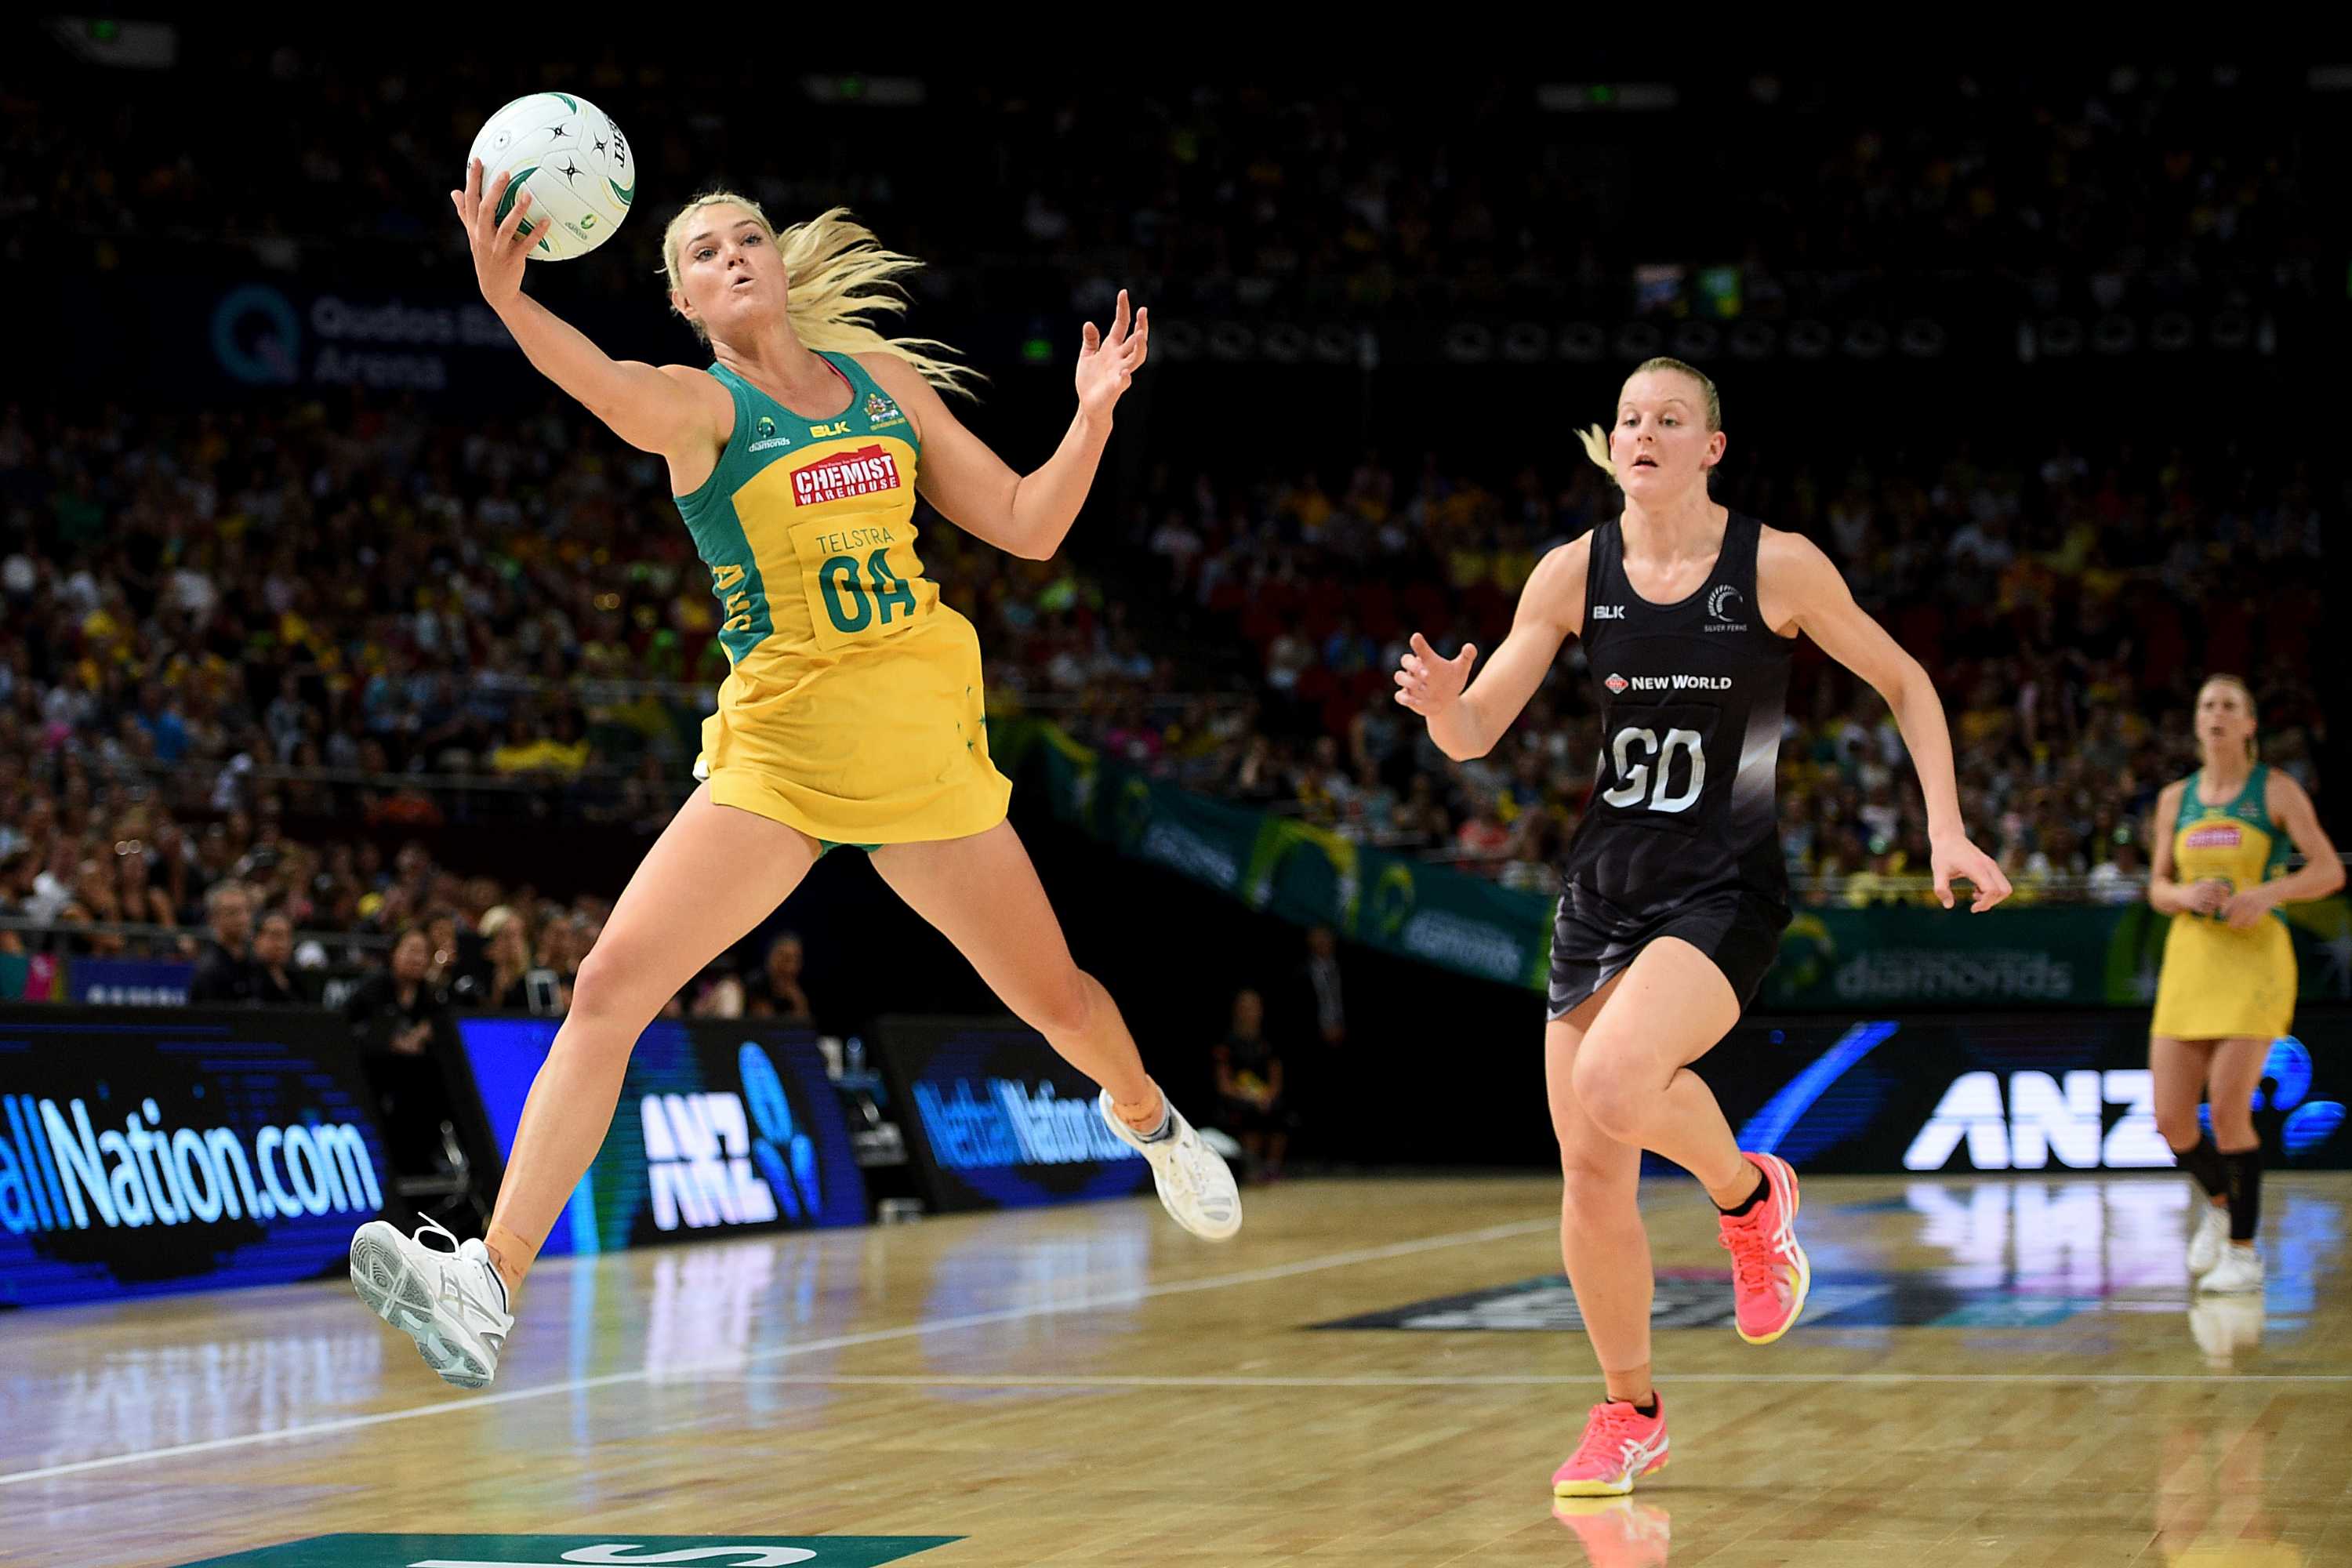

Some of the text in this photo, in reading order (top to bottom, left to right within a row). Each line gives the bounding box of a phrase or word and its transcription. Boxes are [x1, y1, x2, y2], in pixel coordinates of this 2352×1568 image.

[809, 421, 851, 438] BLK
[749, 437, 790, 452] diamonds
[796, 455, 895, 494] CHEMIST
[800, 477, 897, 504] WAREHOUSE
[816, 527, 895, 554] TELSTRA
[1593, 605, 1625, 619] BLK
[1632, 676, 1670, 691] NEW
[1671, 675, 1732, 690] WORLD
[1602, 727, 1706, 813] GD
[1836, 949, 2074, 1000] diamonds
[1903, 1068, 2177, 1171] ANZ
[640, 1092, 778, 1232] ANZ
